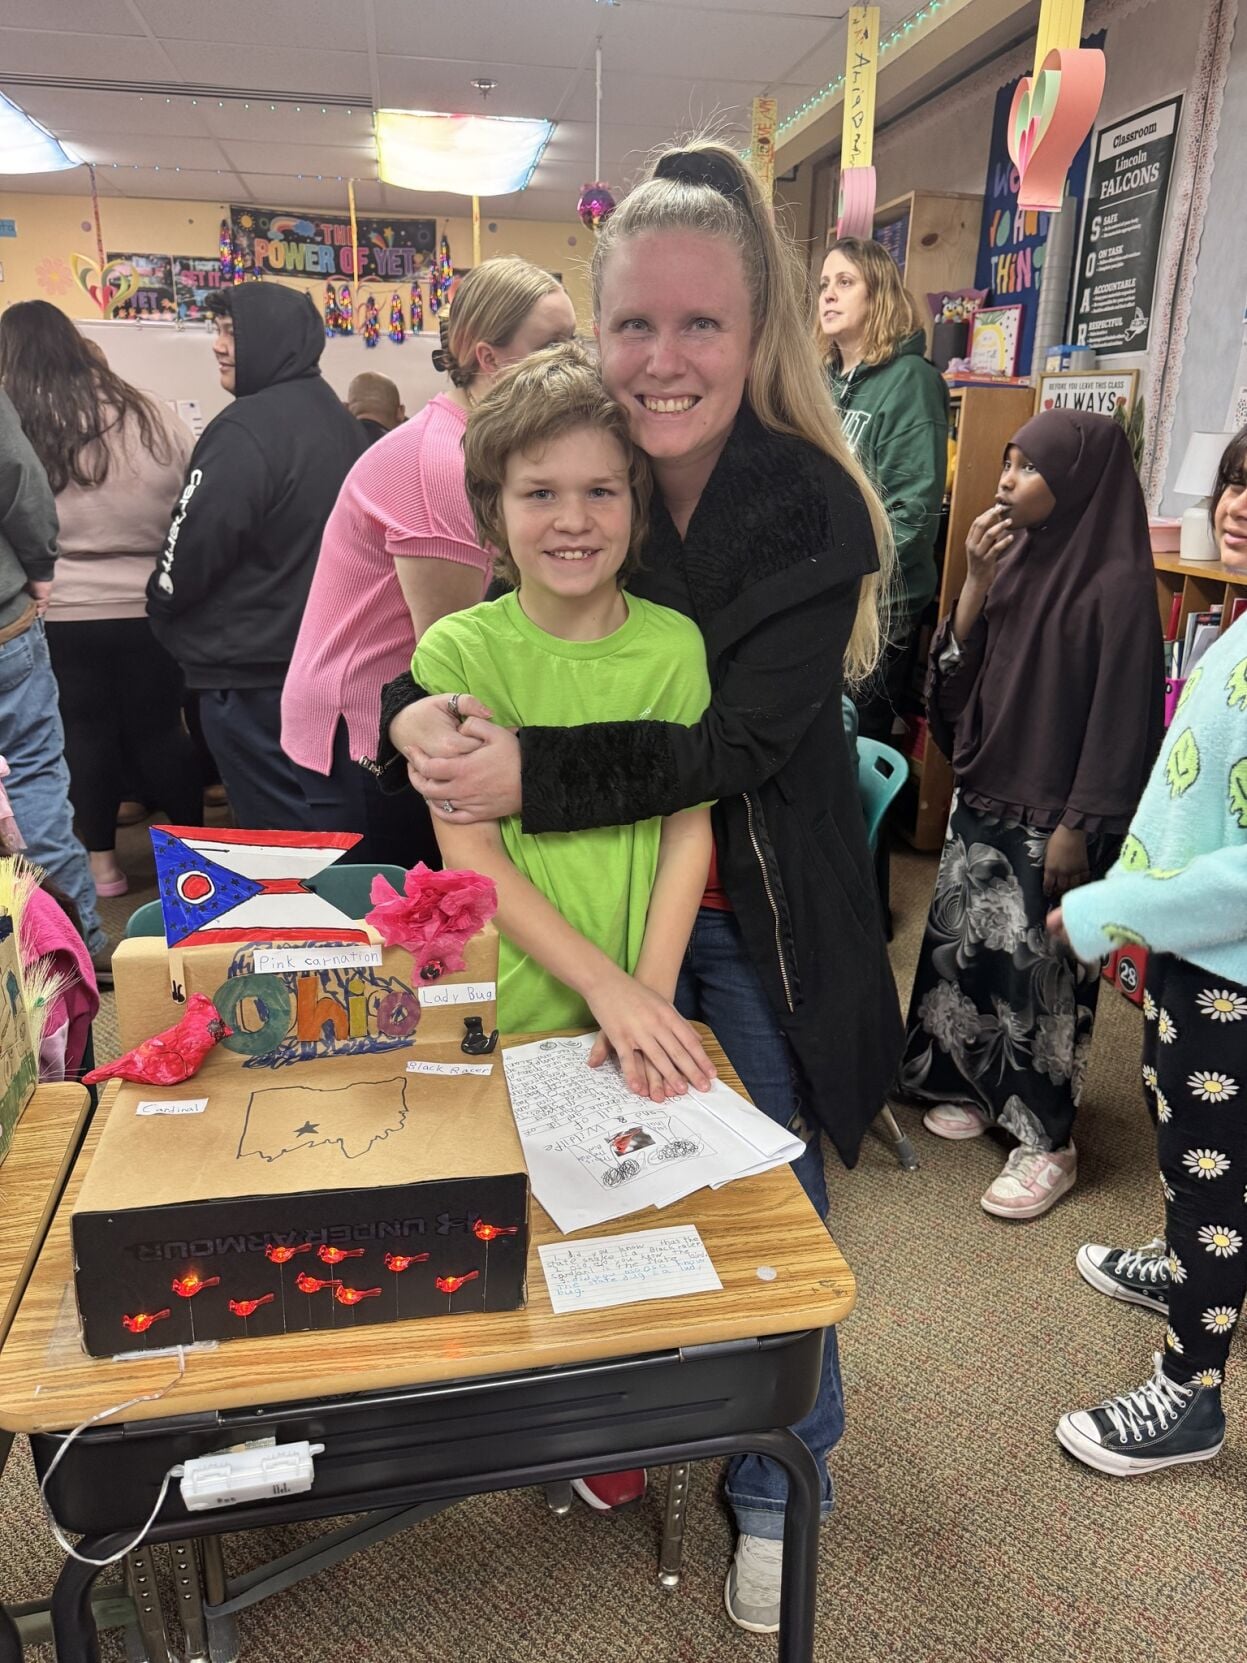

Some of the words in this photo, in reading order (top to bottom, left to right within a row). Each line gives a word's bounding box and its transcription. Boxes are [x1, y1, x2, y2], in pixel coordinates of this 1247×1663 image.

[1113, 122, 1157, 149] Classroom
[1115, 149, 1148, 173] Lincoln
[1100, 162, 1160, 200] FALCONS
[1090, 216, 1102, 242] S
[1103, 213, 1119, 226] SAFE
[254, 238, 335, 273] POWER
[339, 247, 369, 274] OF
[373, 248, 416, 276] YET
[1098, 249, 1108, 260] ON
[1108, 244, 1124, 257] TASK
[1085, 252, 1097, 278] O
[1093, 277, 1137, 295] ACCOUNTABLE
[1080, 288, 1091, 314] A
[1077, 323, 1088, 347] R
[1048, 383, 1067, 391] BEFORE
[1079, 382, 1094, 390] LEAVE
[1108, 381, 1124, 389] CLASS
[1054, 391, 1116, 412] ALWAYS
[259, 954, 297, 971] Pink
[304, 951, 378, 966] carnation
[1120, 962, 1136, 986] 28
[422, 987, 459, 1004] Lady
[467, 986, 492, 1001] Bug
[211, 972, 420, 1058] Ohio
[409, 1061, 444, 1073] Black
[450, 1066, 489, 1075] Racer
[142, 1103, 199, 1114] Cardinal
[305, 1217, 424, 1244] UNDER
[137, 1229, 298, 1261] ARMOUR
